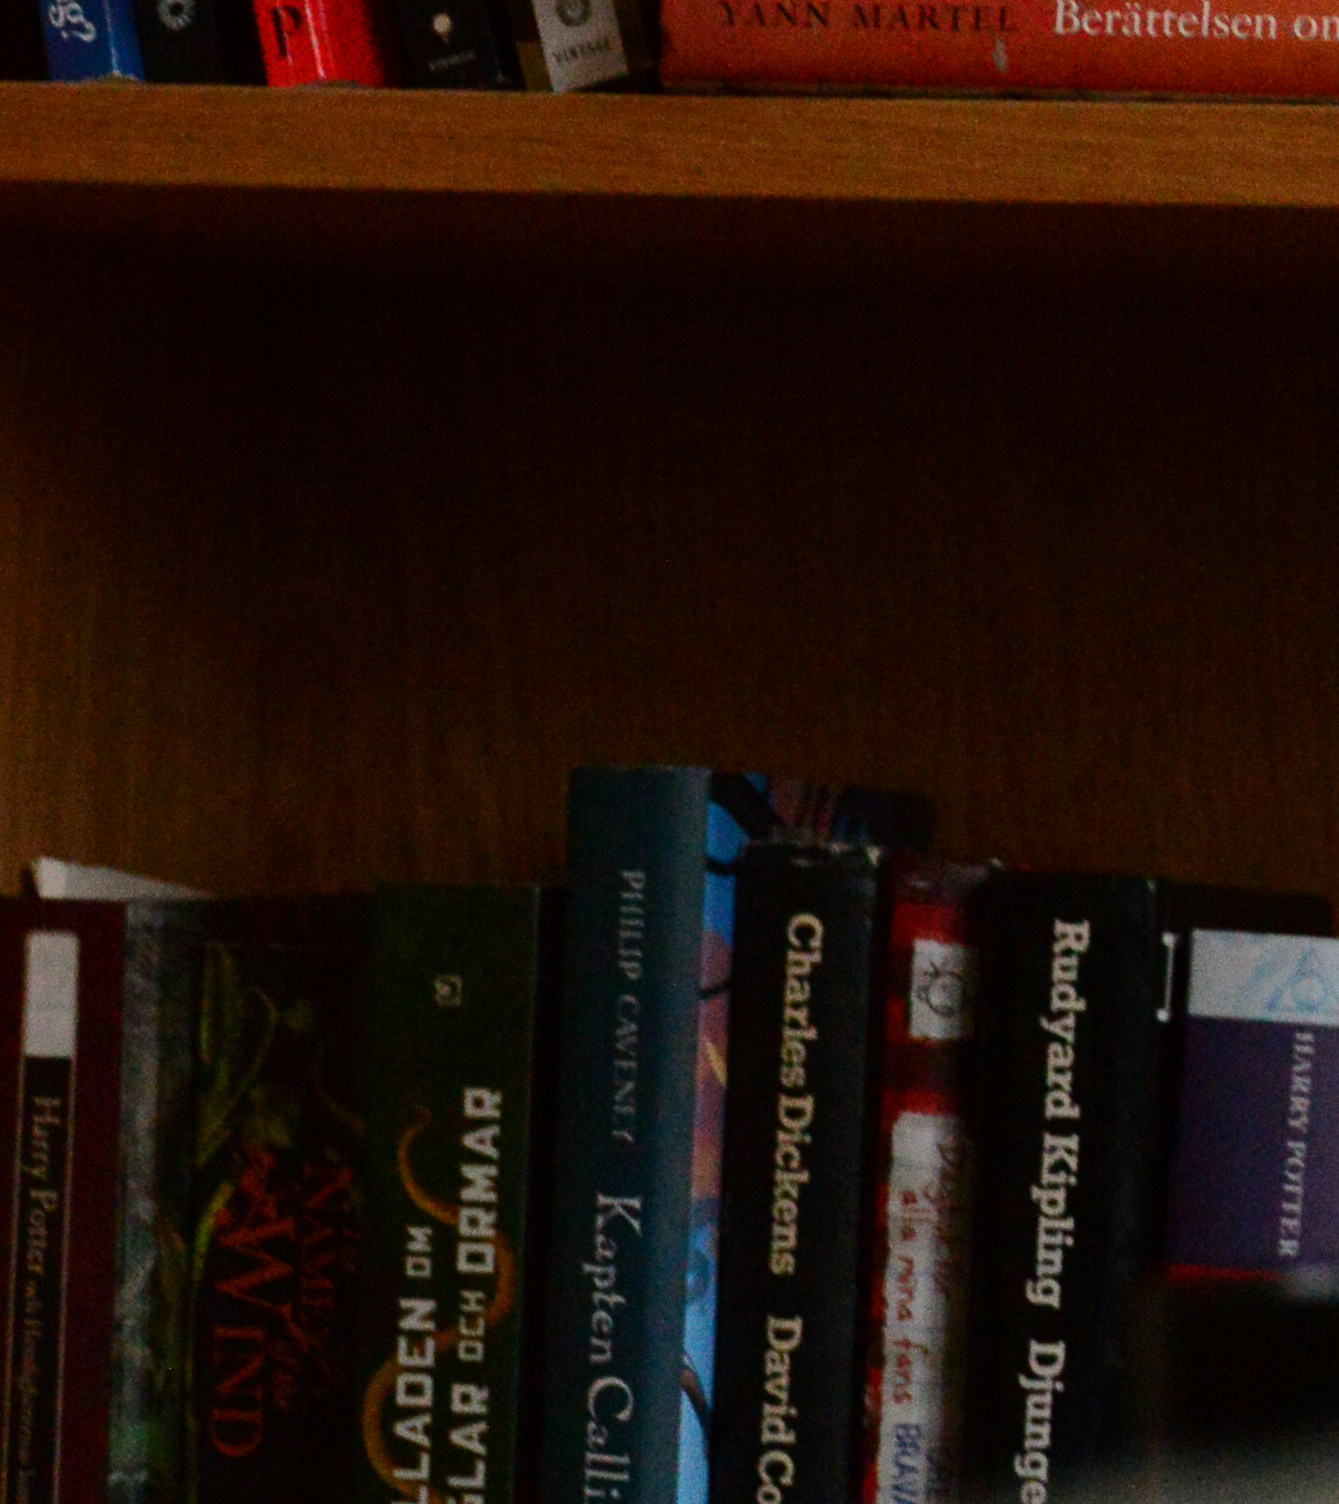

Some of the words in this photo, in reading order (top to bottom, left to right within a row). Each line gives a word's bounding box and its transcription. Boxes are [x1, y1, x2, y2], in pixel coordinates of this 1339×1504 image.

[716, 0, 831, 30] YANN
[849, 1, 1019, 35] MARTEL
[614, 868, 647, 980] PHILIP
[777, 911, 827, 1088] Charles
[1039, 918, 1092, 1120] Rudyard
[610, 993, 641, 1143] CAVENEY
[1283, 1031, 1315, 1135] HARRY
[22, 1094, 62, 1180] Harry
[455, 1085, 504, 1277] ORMAR
[767, 1092, 816, 1276] Dickens
[1276, 1138, 1308, 1258] POTTER
[24, 1186, 59, 1278] Potter
[405, 1224, 435, 1280] OM
[586, 1191, 644, 1365] Kapten
[1027, 1132, 1080, 1307] Kipling
[210, 1213, 297, 1460] WIND
[456, 1290, 488, 1364] OCH
[759, 1313, 805, 1446] David
